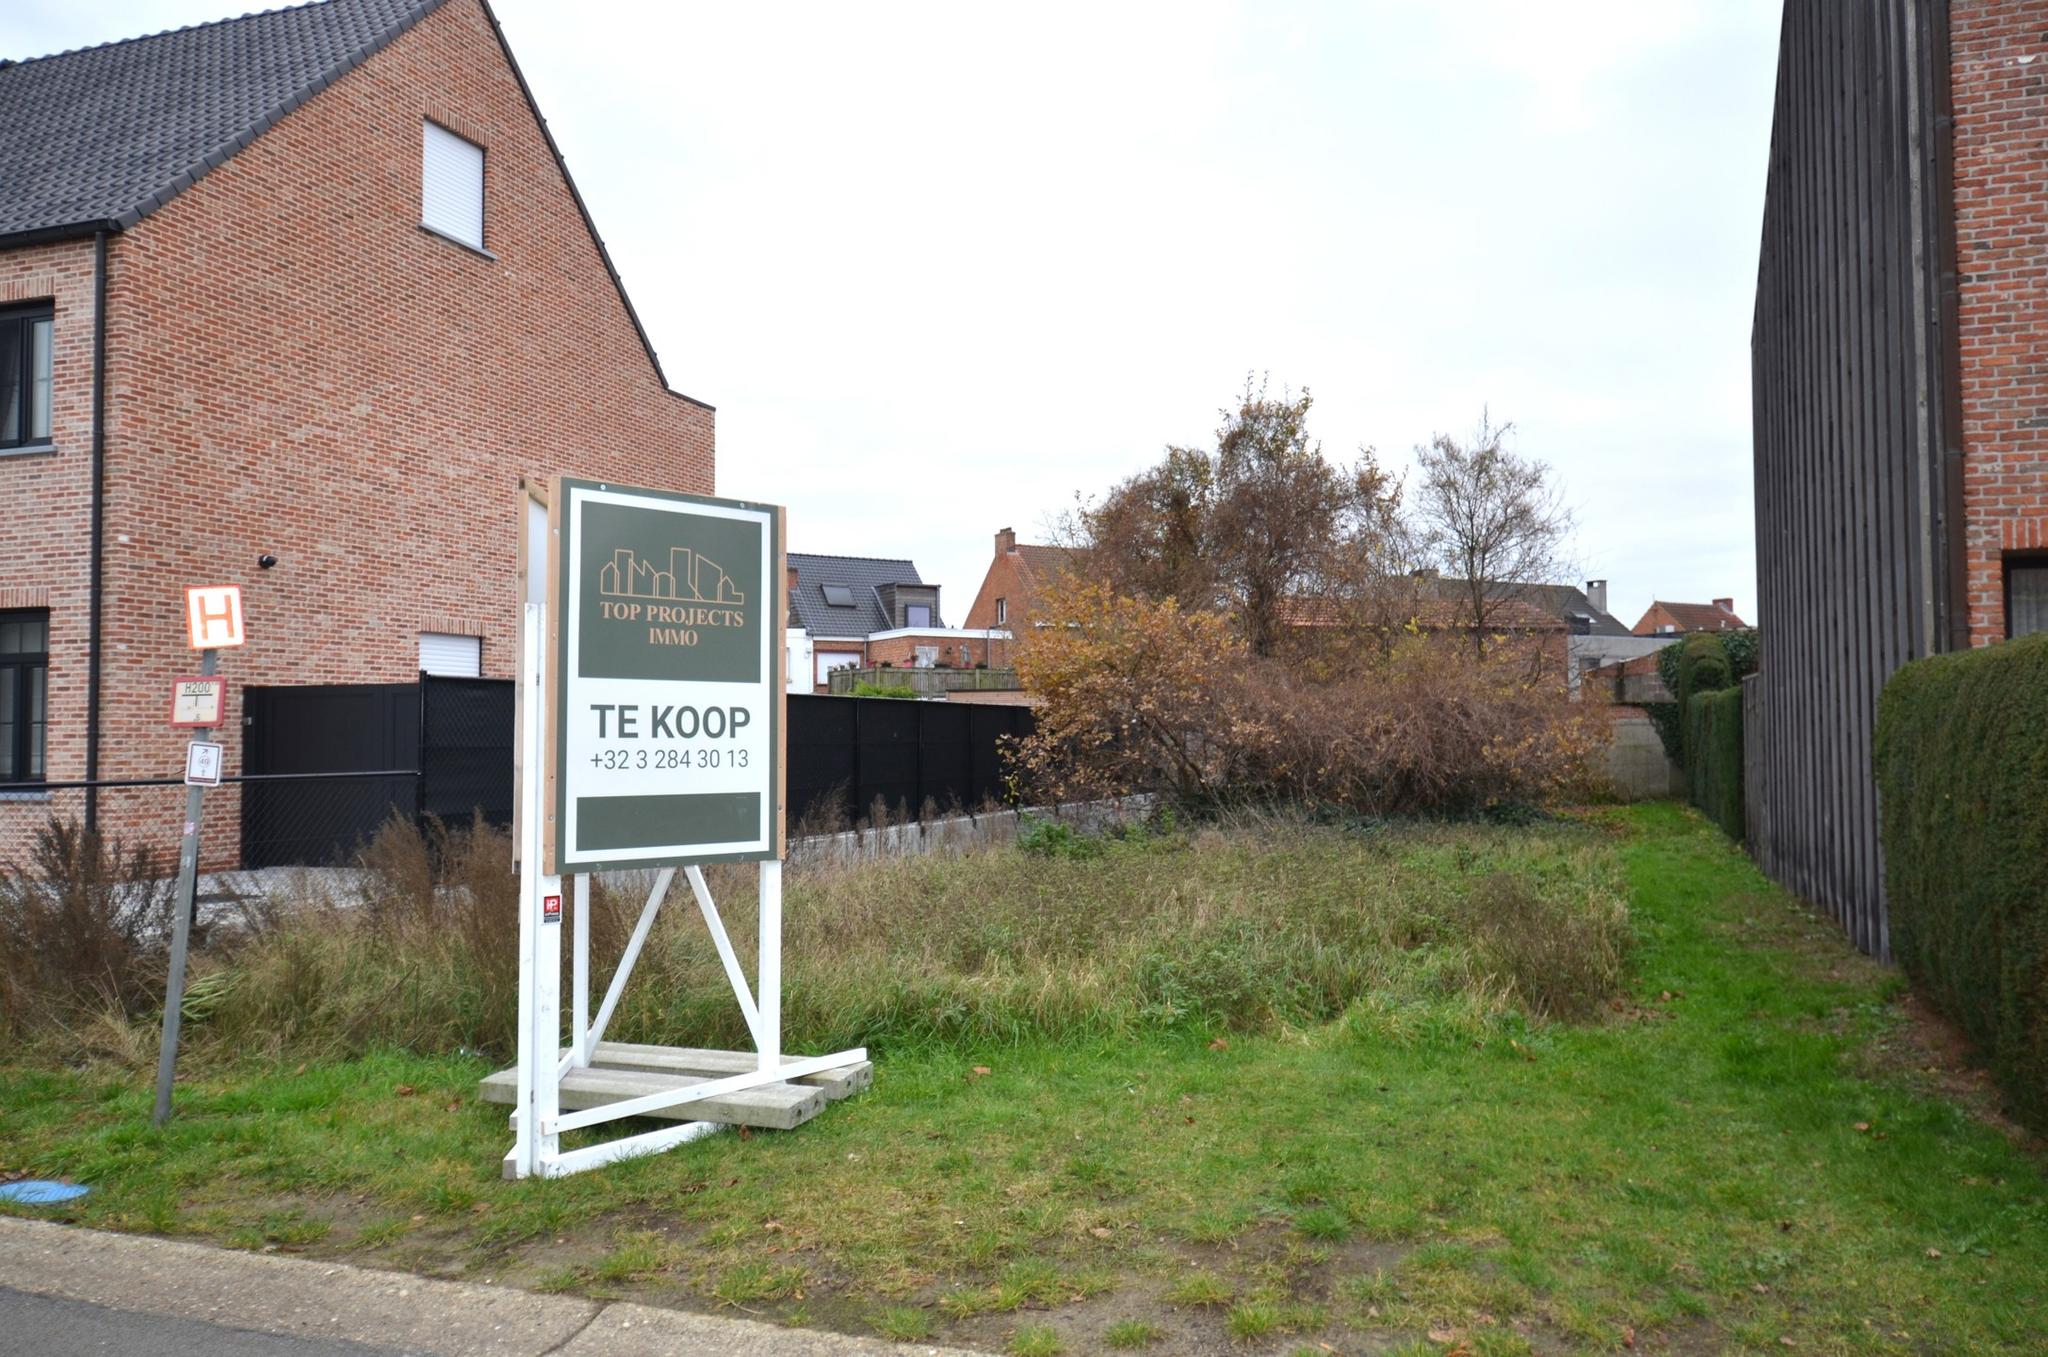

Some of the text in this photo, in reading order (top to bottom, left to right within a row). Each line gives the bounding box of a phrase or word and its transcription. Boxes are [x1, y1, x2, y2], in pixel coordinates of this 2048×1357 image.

[198, 594, 234, 640] H
[600, 601, 744, 628] TOP PROJECTS
[649, 627, 698, 647] IMMO
[184, 681, 210, 694] H200
[590, 704, 751, 739] TE KOOP
[590, 749, 749, 770] +32 3 284 30 13
